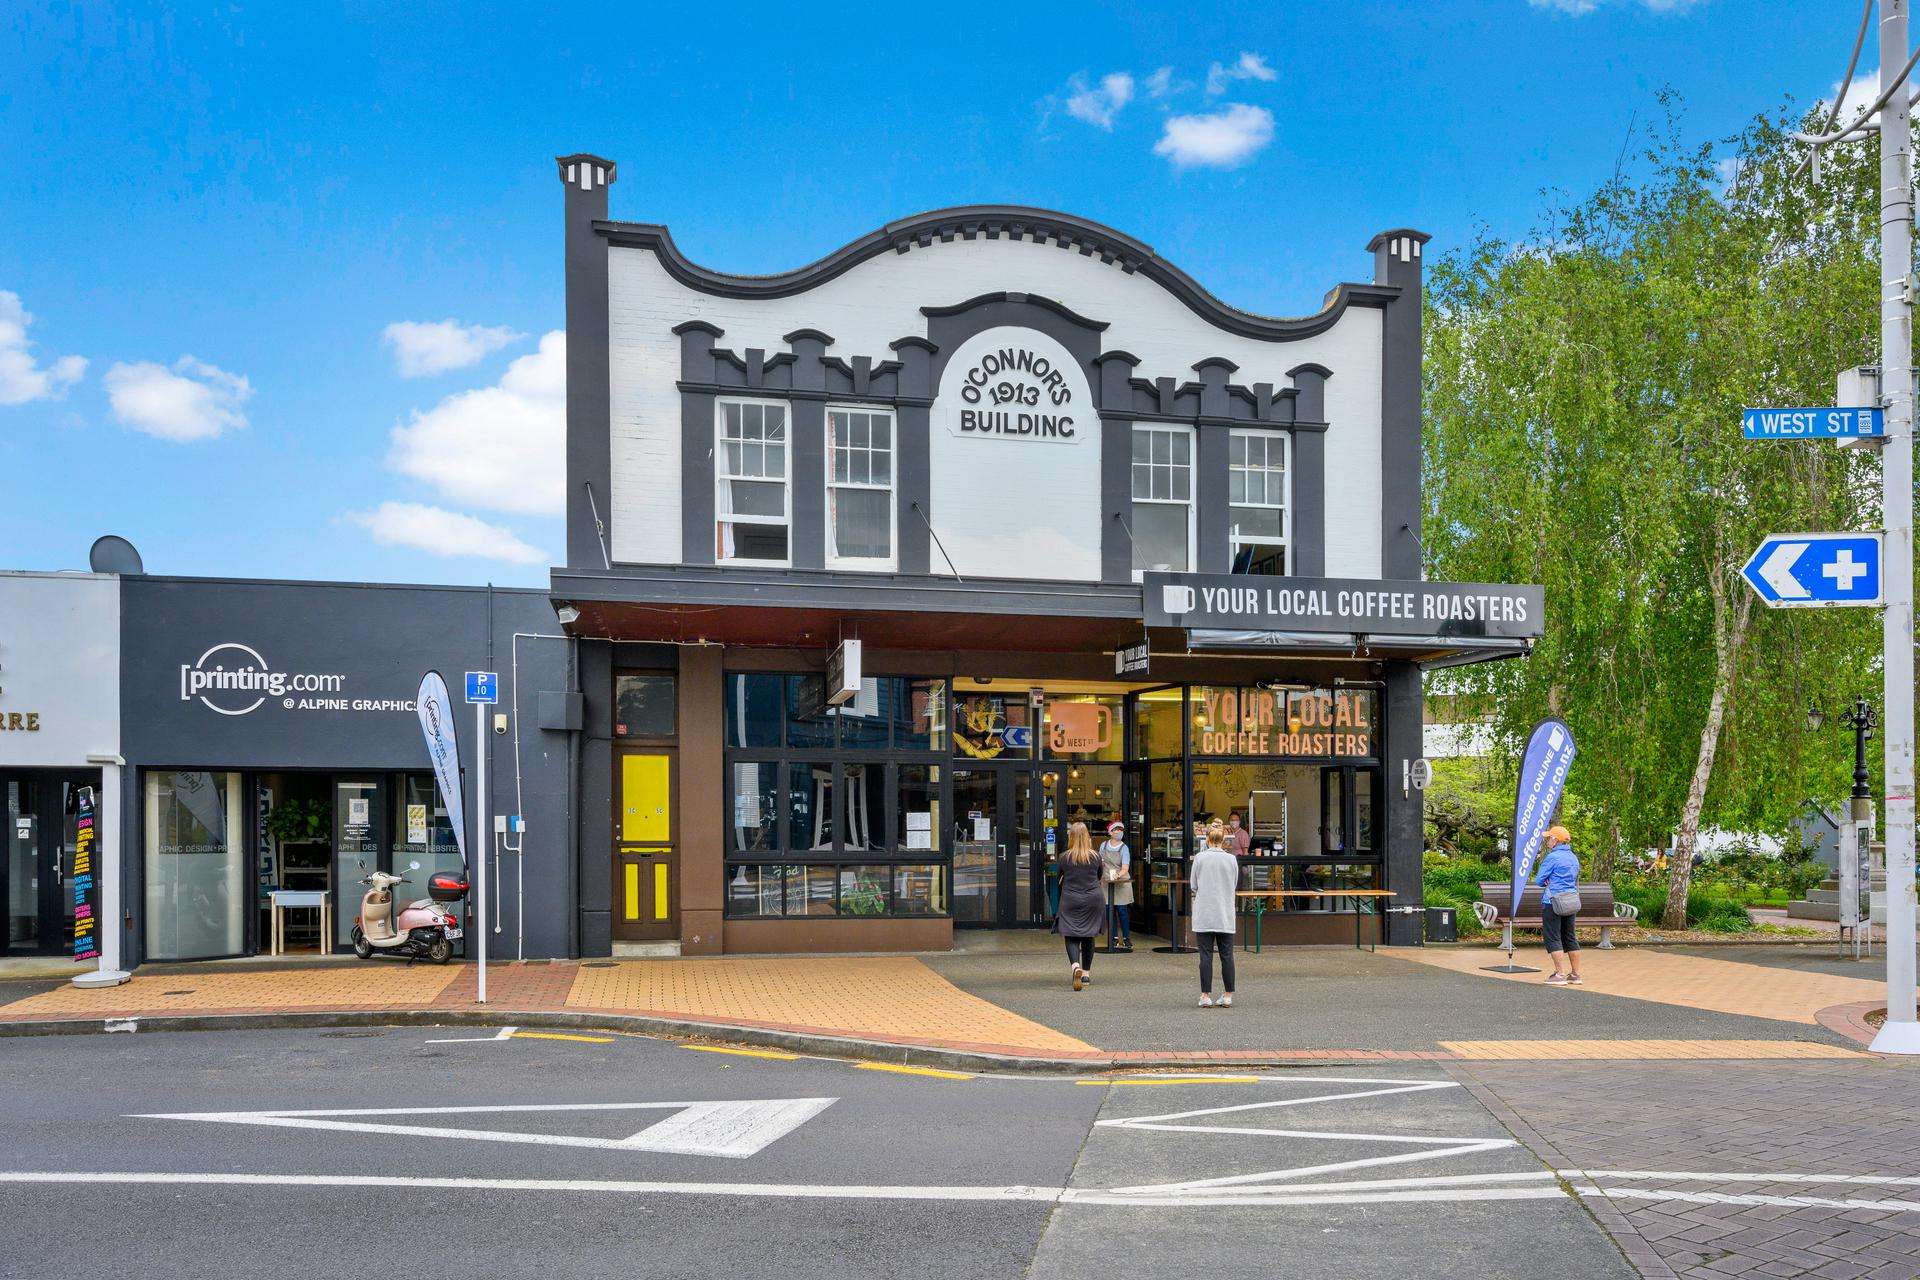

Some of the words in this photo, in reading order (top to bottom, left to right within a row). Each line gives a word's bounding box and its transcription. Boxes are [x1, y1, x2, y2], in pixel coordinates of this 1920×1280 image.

[961, 348, 1071, 406] O'CONNOR'S
[988, 381, 1040, 406] 1913
[960, 409, 1074, 438] BUILDING
[1761, 413, 1816, 433] WEST
[1827, 412, 1852, 433] ST
[1202, 587, 1258, 614] YOUR
[1267, 589, 1332, 616] LOCAL
[1338, 590, 1414, 618] COFFEE
[1423, 593, 1527, 622] ROASTERS
[477, 686, 487, 695] 10
[478, 675, 488, 685] P
[298, 699, 348, 710] ALPINE
[352, 700, 418, 711] GRAPHICS
[1202, 690, 1274, 728] YOUR
[1286, 694, 1368, 728] LOCAL
[1054, 724, 1065, 747] 3
[1068, 739, 1086, 747] WEST
[1202, 732, 1269, 754] COFFEE
[1279, 733, 1368, 756] ROASTERS
[1519, 793, 1537, 835] ORDER
[1533, 749, 1555, 793] ONLINE
[1518, 744, 1573, 877] coffeeorder.co.nz
[362, 843, 377, 851] DES
[428, 844, 459, 852] EBSITE
